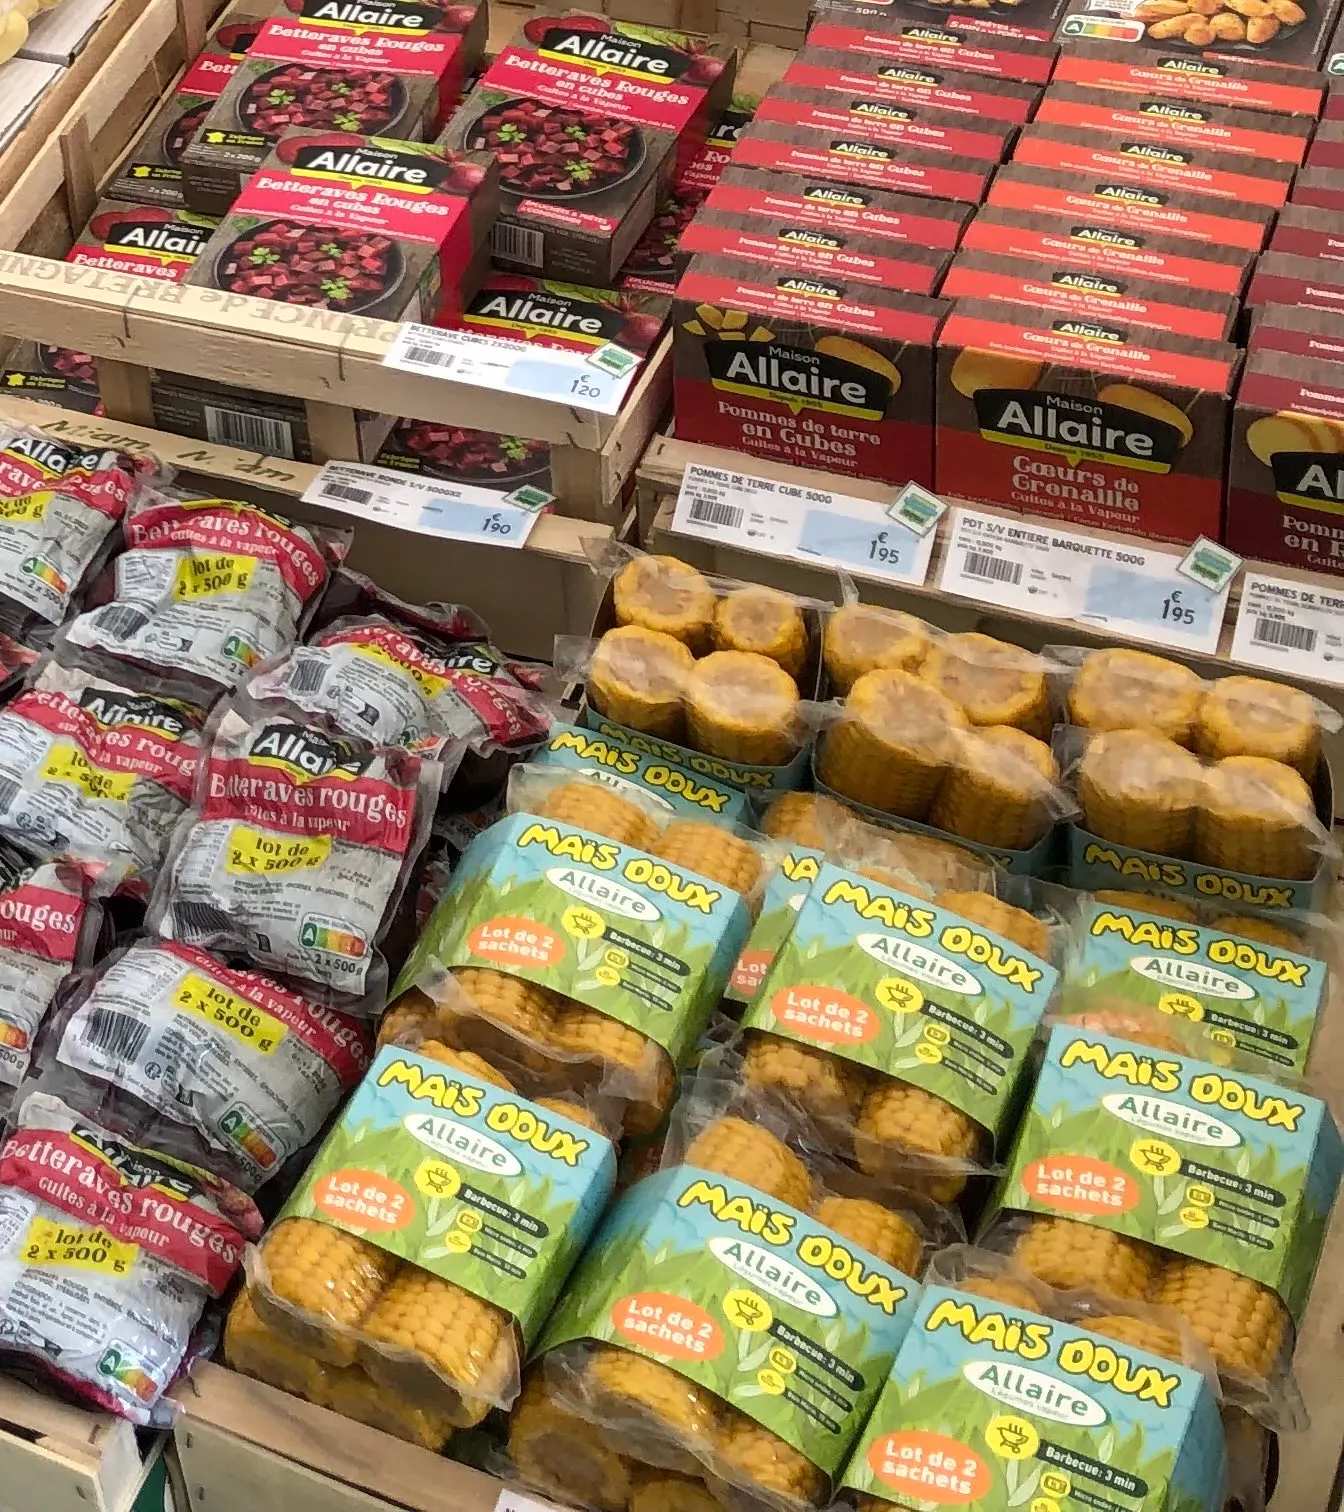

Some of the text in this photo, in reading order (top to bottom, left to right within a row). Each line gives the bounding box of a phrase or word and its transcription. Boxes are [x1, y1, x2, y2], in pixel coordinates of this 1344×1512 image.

[314, 1, 424, 29] Allaire
[268, 24, 445, 55] Betteraves Rouges
[559, 34, 669, 75] Allaire
[769, 346, 820, 365] Maison
[726, 352, 867, 405] Allaire
[717, 402, 796, 428] Pommes
[801, 416, 826, 434] de
[1046, 396, 1103, 416] Maison
[742, 423, 774, 441] en
[997, 402, 1154, 456] Allaire
[690, 466, 728, 482] POMMES
[731, 475, 744, 485] DE
[747, 478, 775, 492] TERRE
[778, 485, 802, 498] CUBE
[1112, 476, 1140, 494] de
[962, 517, 1146, 566] PDT S/V ENTIERE BARQUETTE 500G
[320, 787, 408, 826] rouges
[255, 837, 311, 857] lot de
[823, 879, 1045, 994] MAÏS DOUX
[870, 935, 968, 987] Allaire
[378, 1059, 590, 1168] MAÏS DOUX
[416, 1117, 510, 1168] Allaire
[322, 1192, 399, 1226] sachets
[327, 1176, 405, 1209] Lot de 2
[138, 1198, 240, 1265] rouges
[926, 1299, 1183, 1409] MAÏS DOUX
[978, 1363, 1091, 1421] Allaire
